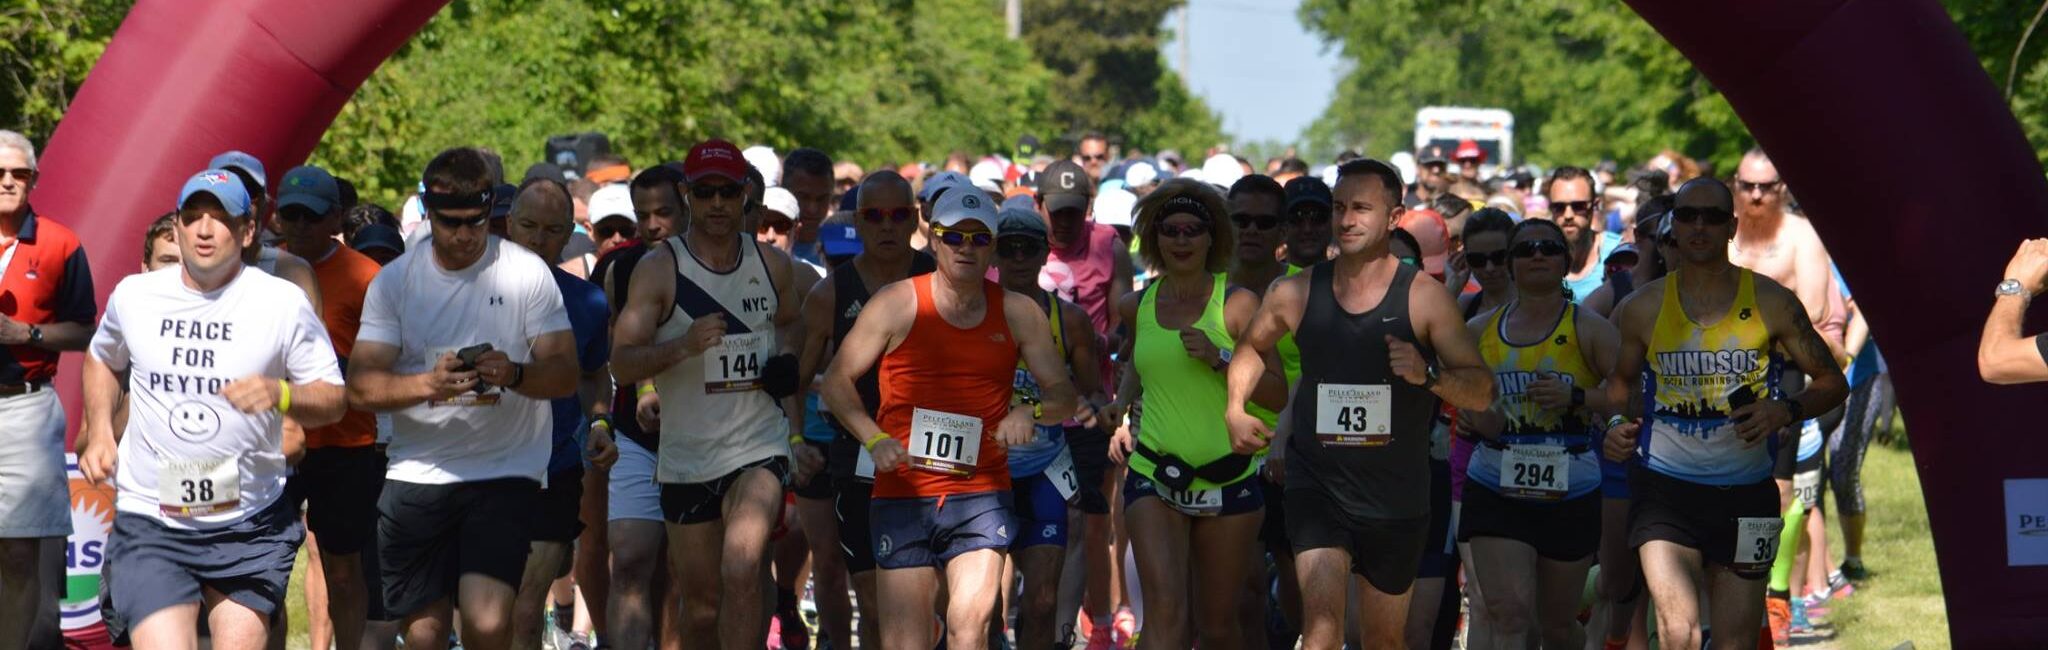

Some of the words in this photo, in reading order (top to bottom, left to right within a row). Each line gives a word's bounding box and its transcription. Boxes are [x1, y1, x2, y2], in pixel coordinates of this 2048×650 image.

[1061, 171, 1075, 189] C
[742, 297, 768, 312] NYC
[160, 319, 233, 341] PEACE
[172, 347, 215, 368] FOR
[719, 352, 759, 379] 144
[1656, 349, 1759, 376] WINDSOR
[150, 372, 238, 395] PEYTO
[1337, 406, 1367, 432] 43
[924, 431, 964, 460] 101
[1062, 466, 1077, 491] 2
[1513, 462, 1555, 487] 294
[181, 478, 214, 503] 38
